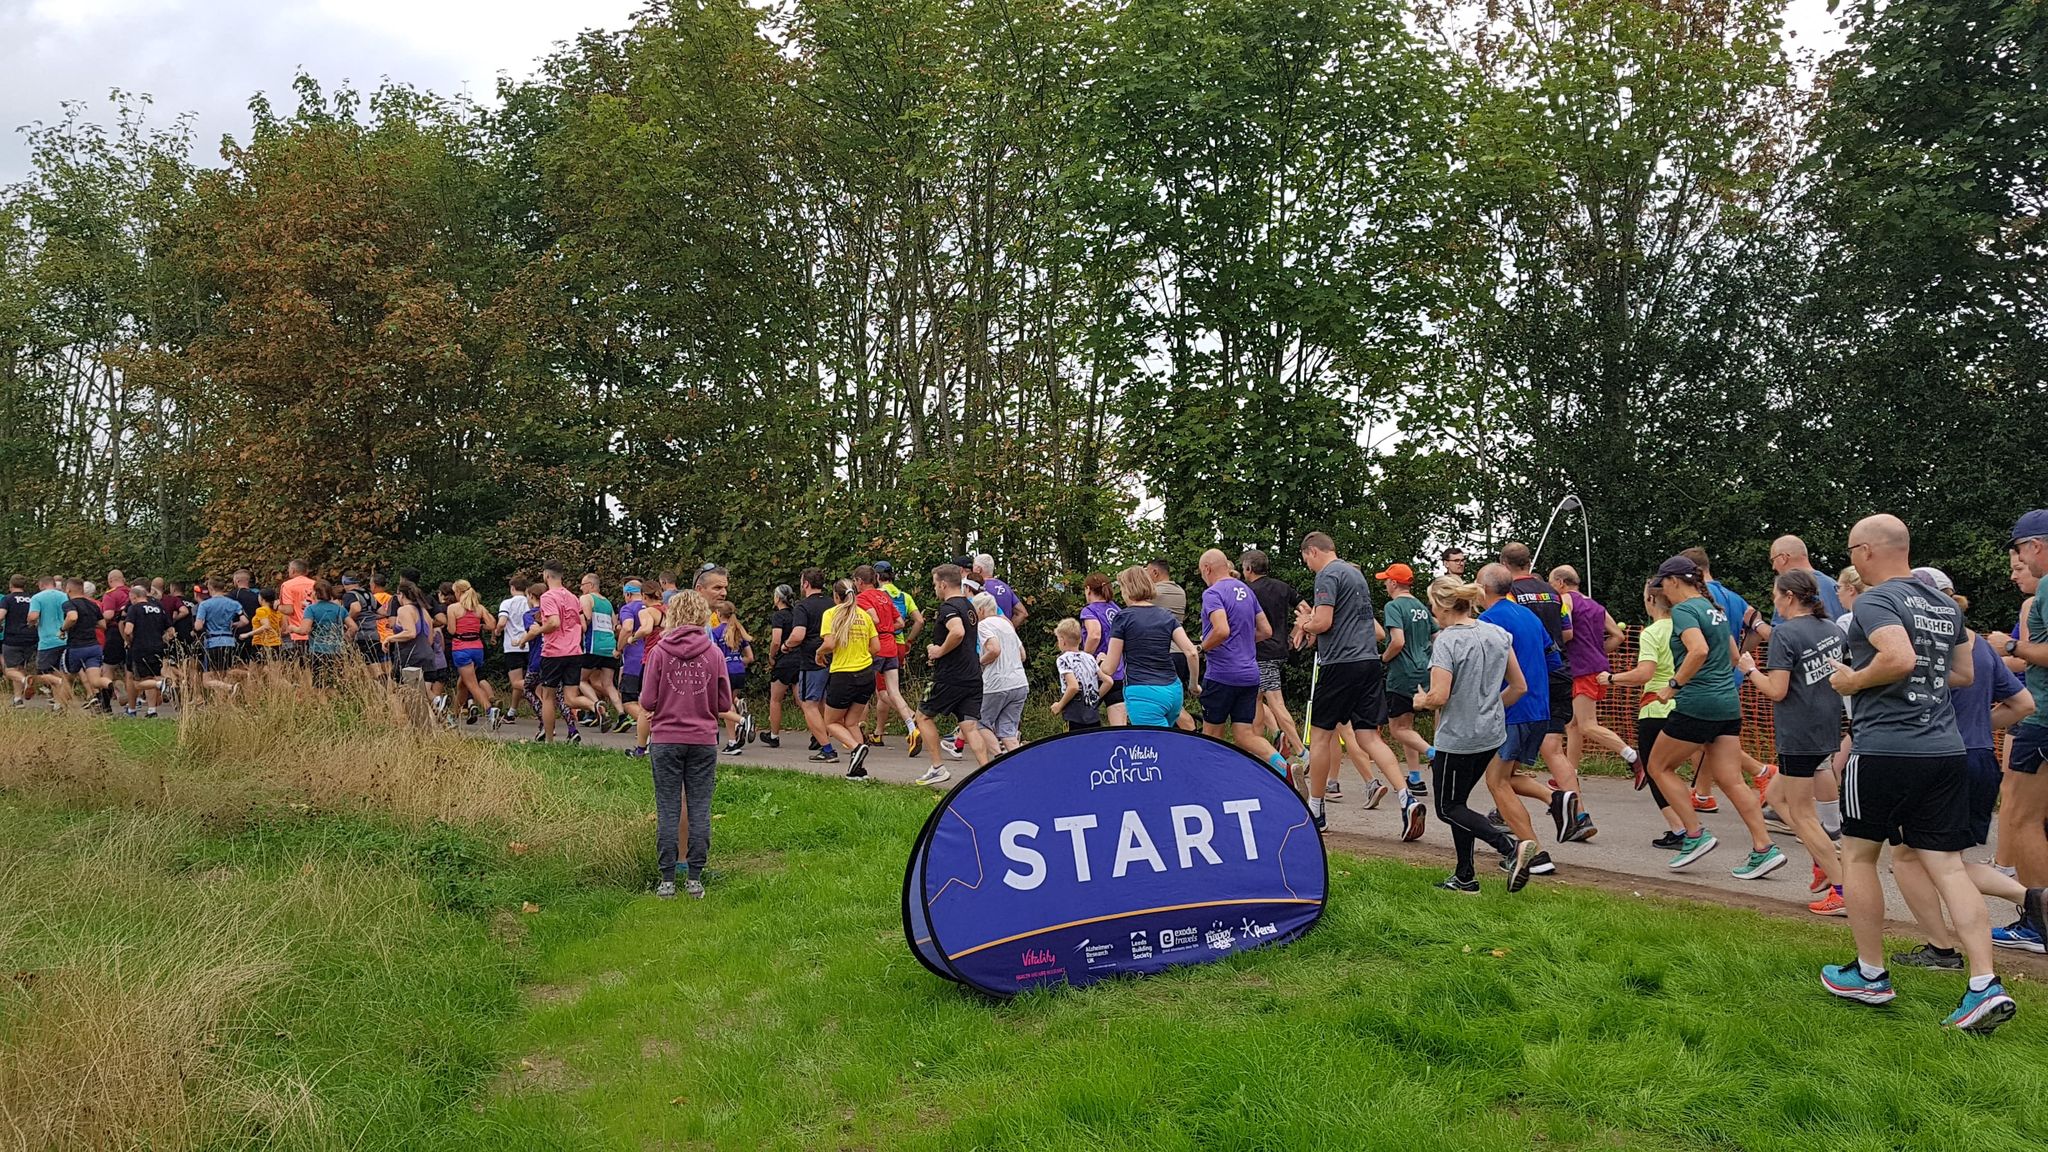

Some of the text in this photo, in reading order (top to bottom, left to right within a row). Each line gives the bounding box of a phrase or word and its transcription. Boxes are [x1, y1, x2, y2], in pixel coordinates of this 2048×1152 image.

[1233, 586, 1247, 600] 25
[14, 595, 33, 604] 100
[143, 605, 161, 614] 100
[1410, 608, 1428, 622] 250
[1915, 615, 1954, 634] FINSHER
[677, 661, 703, 669] JACK
[1803, 657, 1822, 672] I'M
[674, 670, 706, 678] WILLS
[1129, 745, 1159, 763] Vitality
[1090, 758, 1162, 790] parkrun
[999, 798, 1261, 890] START
[1174, 926, 1198, 937] exodus
[1253, 922, 1278, 938] Persil
[1131, 939, 1147, 947] Leeds
[1175, 935, 1198, 945] travels
[1085, 943, 1114, 953] Alzheimer's
[1132, 945, 1153, 953] Building
[1022, 948, 1056, 968] Vitality
[1085, 950, 1109, 958] Research
[1132, 952, 1153, 960] Society
